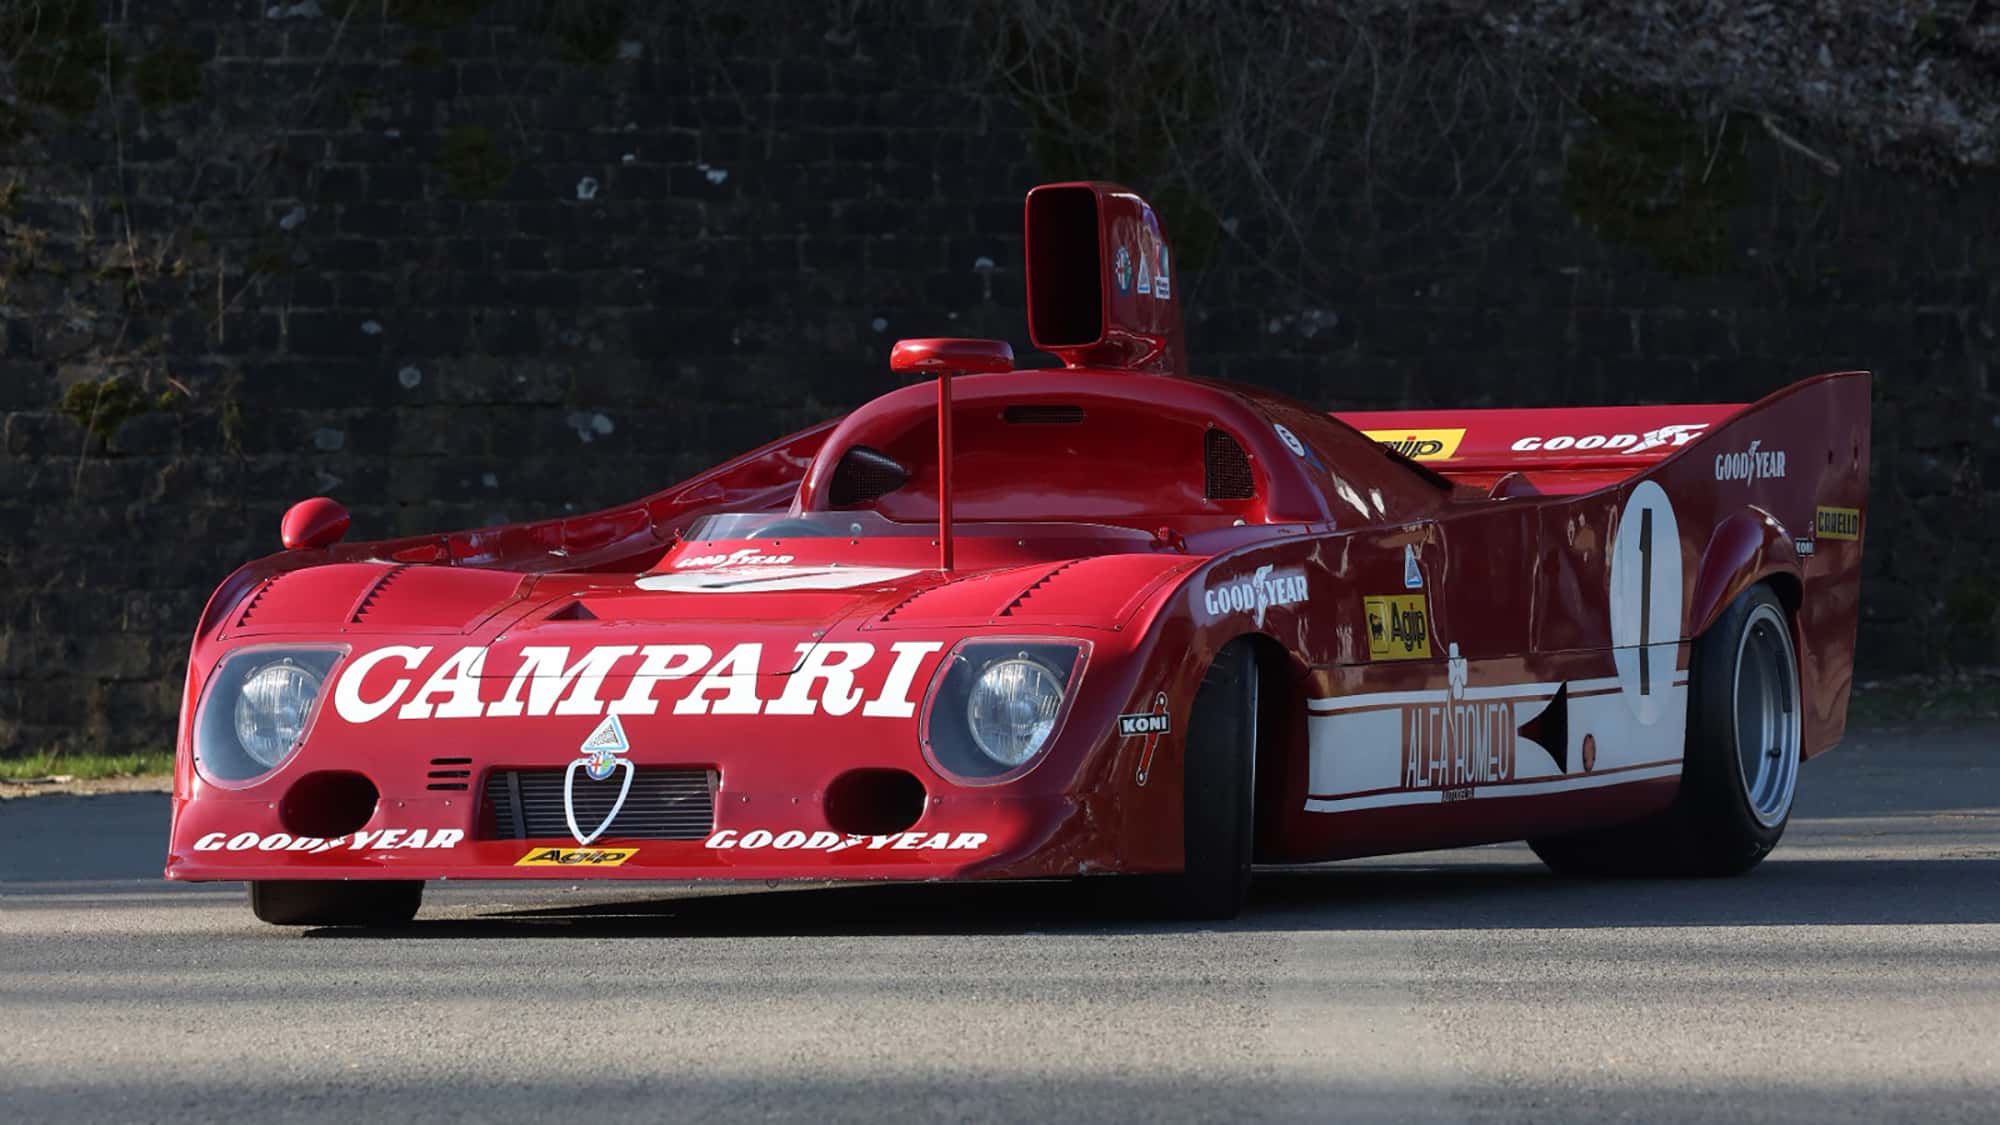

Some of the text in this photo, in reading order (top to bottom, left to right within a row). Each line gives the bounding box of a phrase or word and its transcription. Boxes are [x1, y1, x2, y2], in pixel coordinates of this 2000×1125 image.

[1715, 447, 1786, 482] GOODYEAR
[675, 551, 795, 568] GOODYEAR
[1205, 570, 1309, 620] GOODYEAR
[1640, 508, 1653, 696] 1
[1391, 602, 1426, 652] Agip
[334, 640, 944, 724] CAMPARI
[1122, 715, 1168, 734] KONI
[1406, 702, 1510, 789] ALFA ROMEO
[193, 828, 465, 854] GOODYEAR
[527, 849, 626, 864] Agip
[705, 829, 989, 852] GOODYEAR
